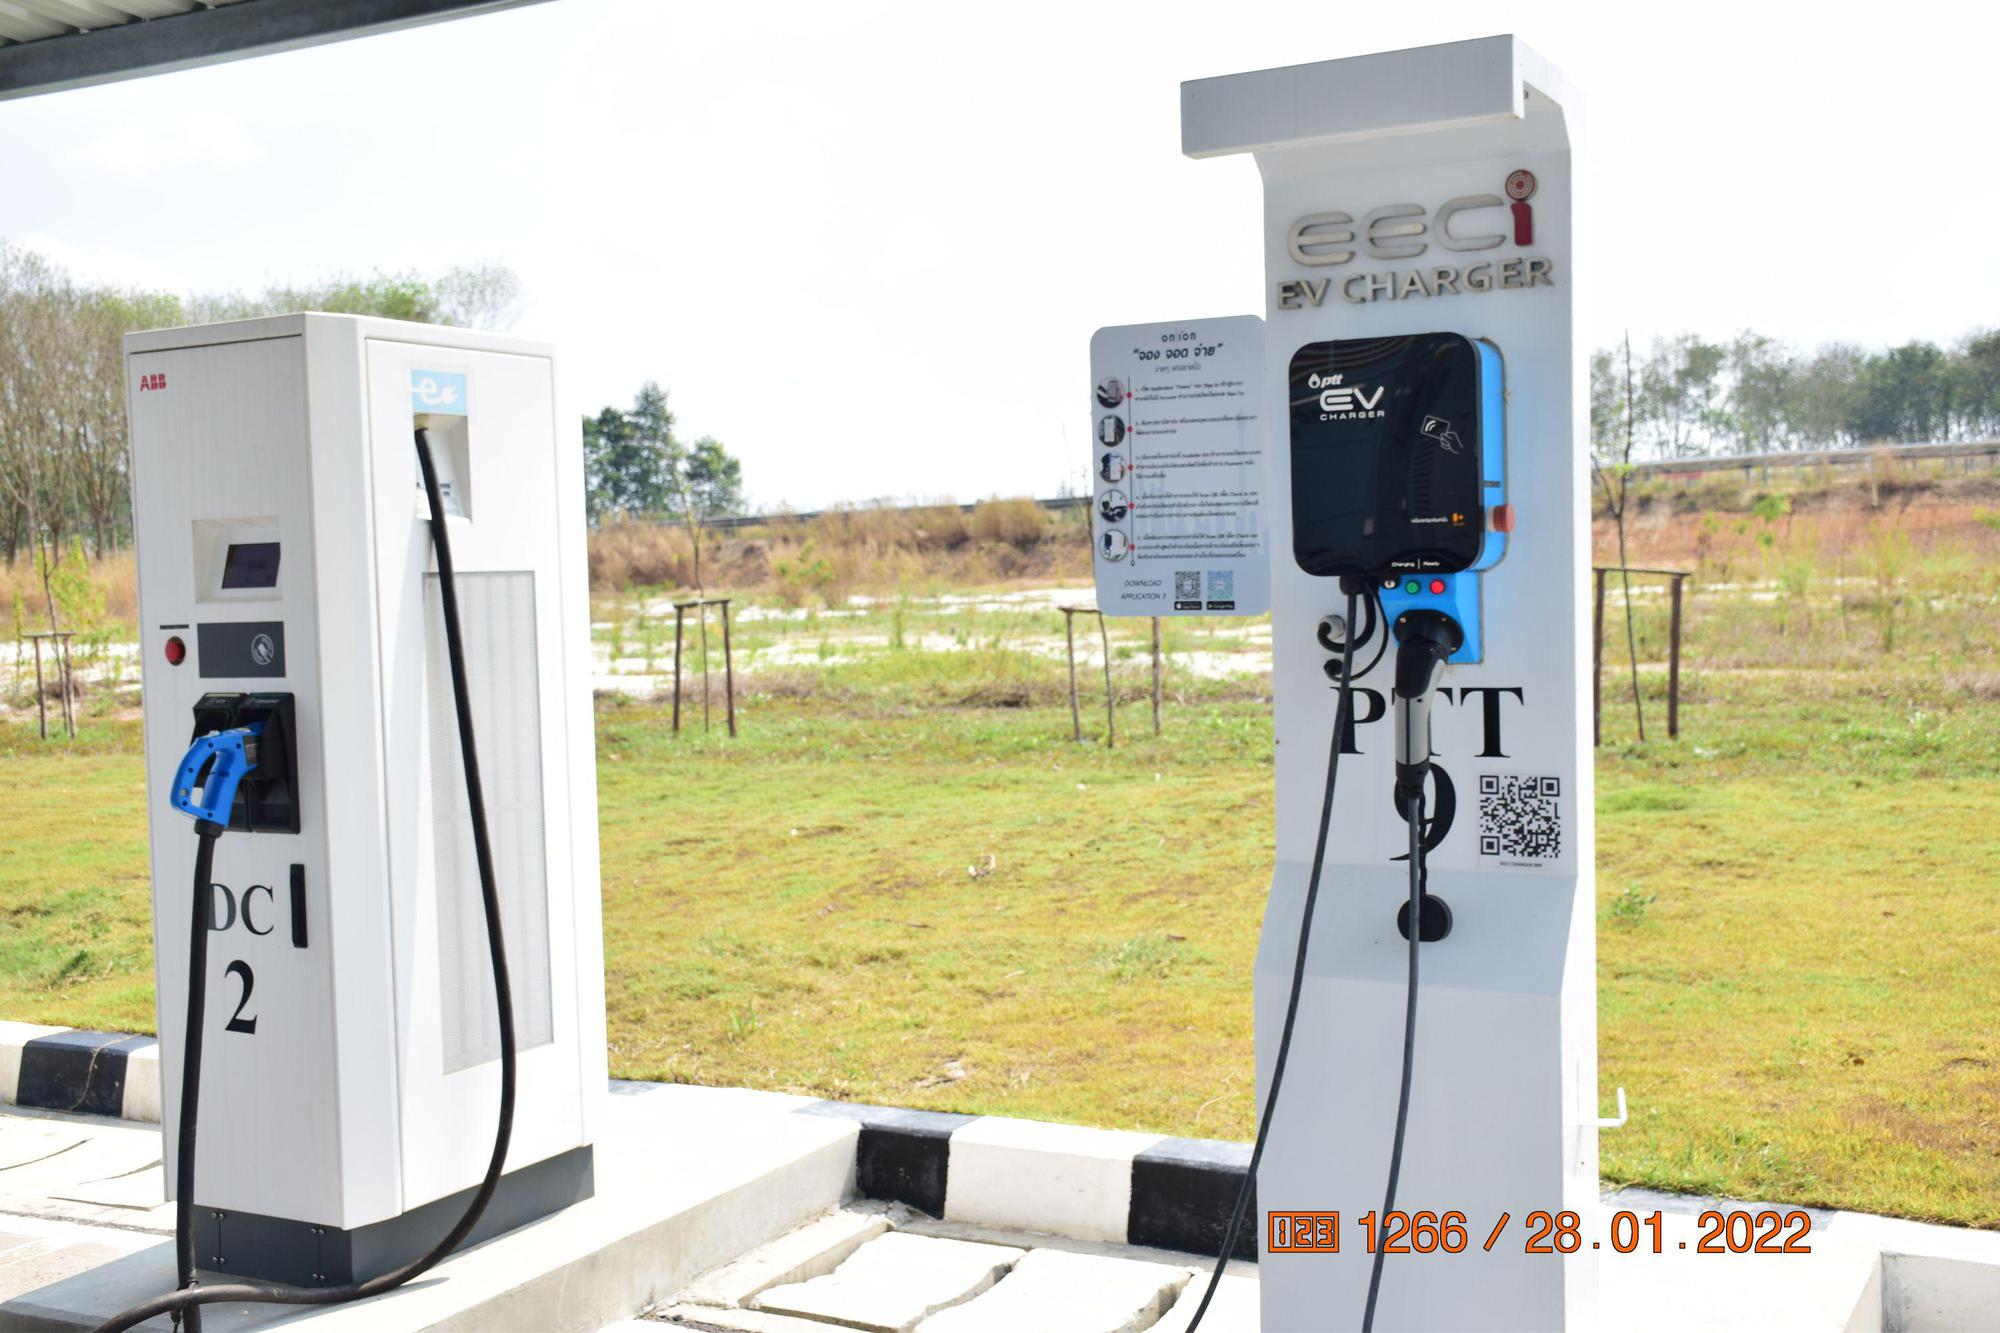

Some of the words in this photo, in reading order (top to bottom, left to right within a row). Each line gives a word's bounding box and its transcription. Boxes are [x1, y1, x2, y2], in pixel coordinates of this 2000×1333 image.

[1277, 277, 1331, 310] EV
[1340, 256, 1554, 304] CHARGER
[140, 373, 167, 391] ABB
[1320, 373, 1344, 388] ptt
[1319, 386, 1385, 412] EV
[1320, 410, 1386, 422] CHARGER
[1124, 579, 1162, 587] DOWNLOAD
[1330, 686, 1524, 758] PT
[206, 882, 275, 936] DC
[223, 959, 258, 1035] 2
